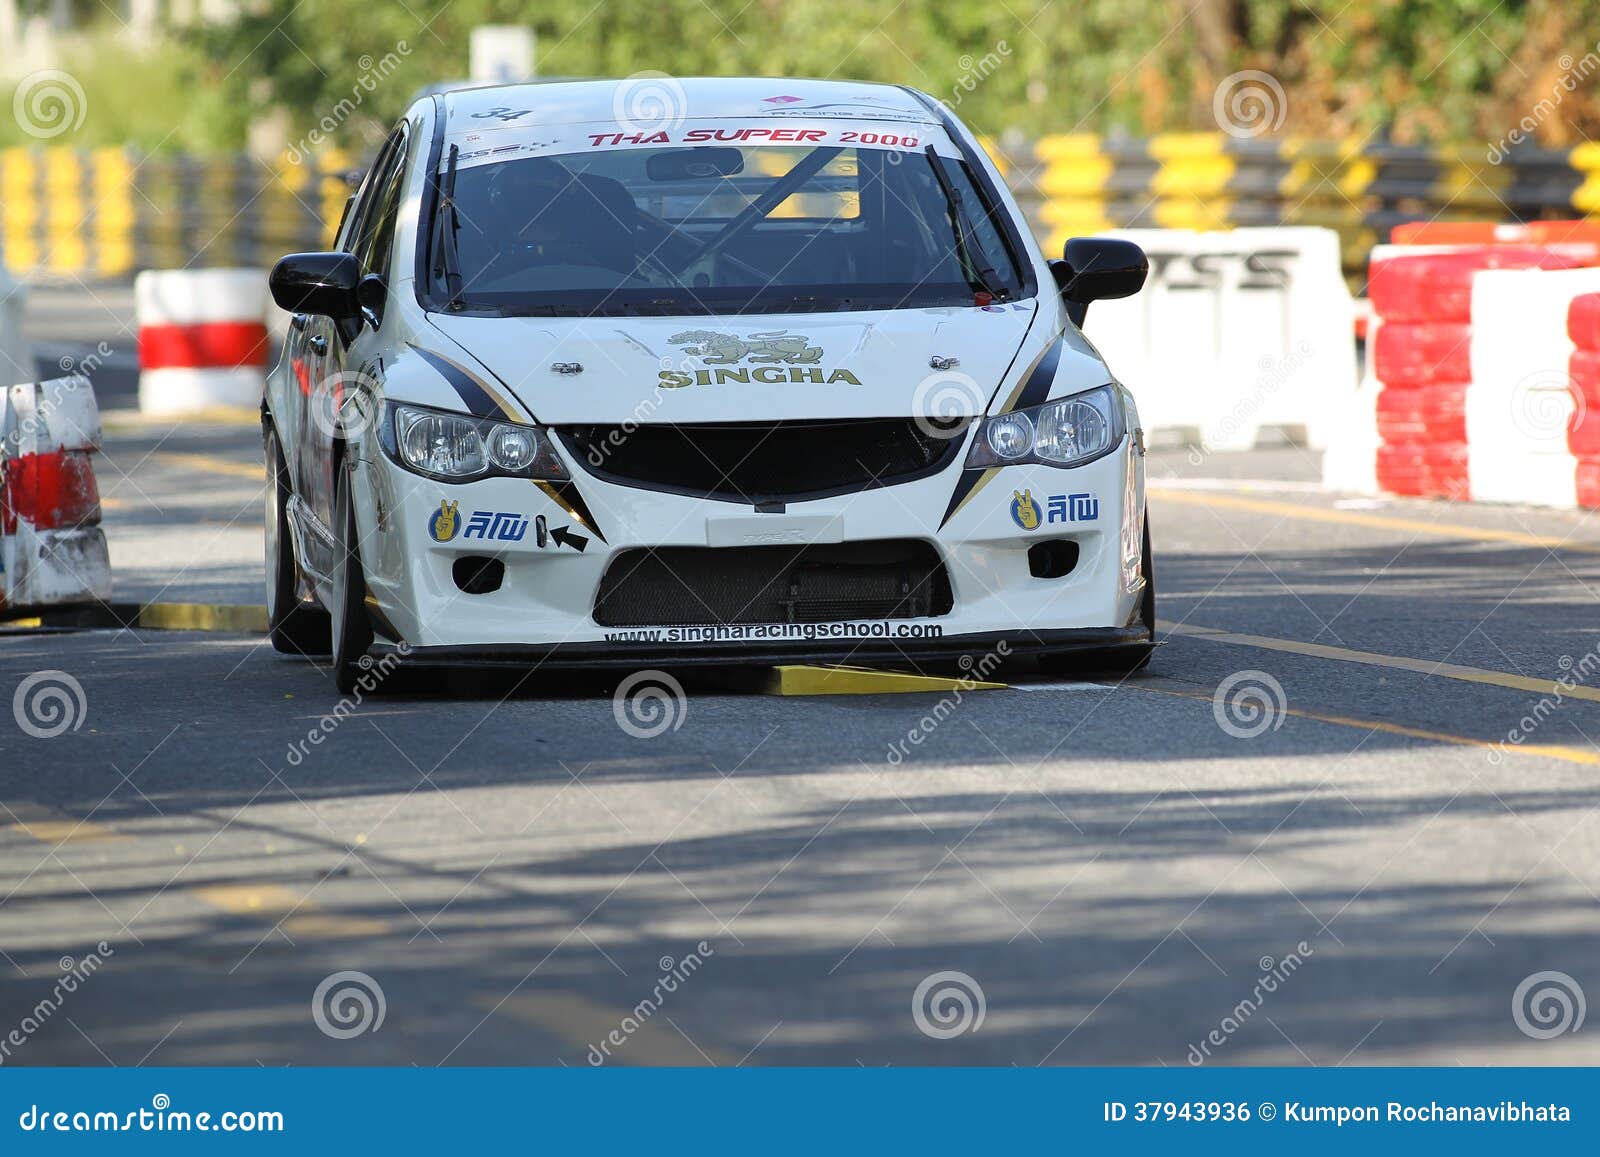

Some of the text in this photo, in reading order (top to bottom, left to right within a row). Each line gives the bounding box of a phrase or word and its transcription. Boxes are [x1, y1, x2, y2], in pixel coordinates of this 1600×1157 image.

[471, 107, 532, 121] 34
[588, 129, 919, 148] THA SUPER 2000
[658, 367, 863, 389] SINGHA
[604, 620, 943, 644] www.singharacingschool.com
